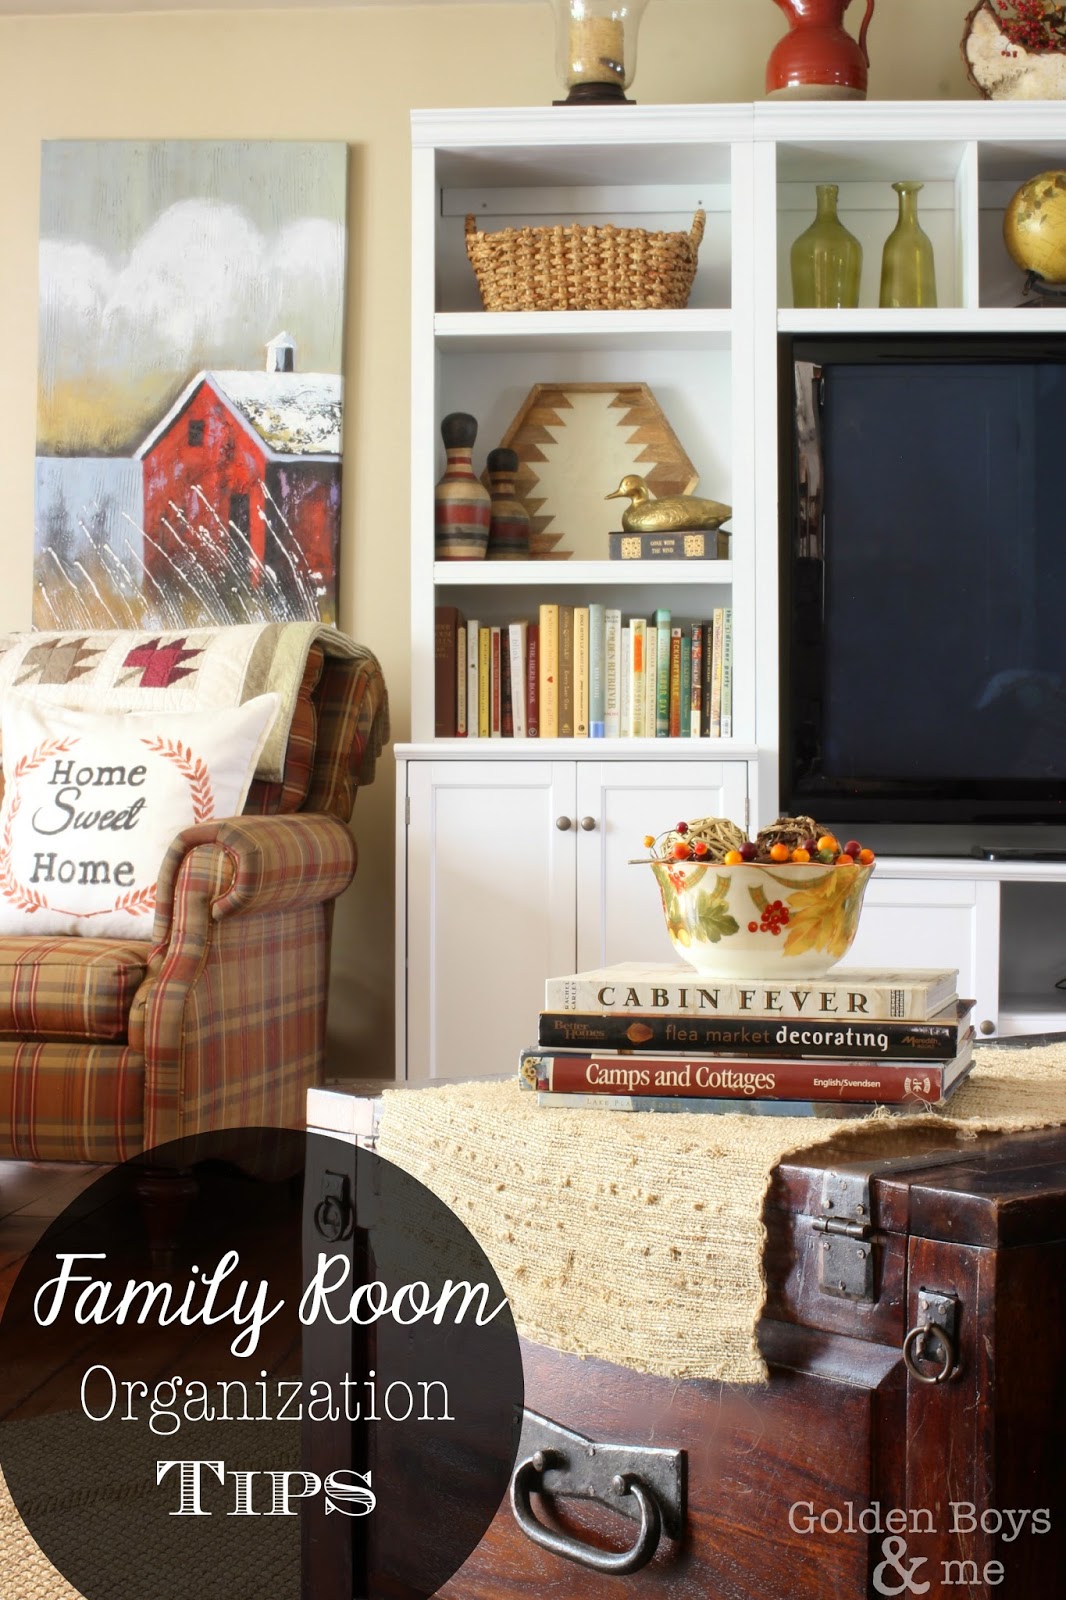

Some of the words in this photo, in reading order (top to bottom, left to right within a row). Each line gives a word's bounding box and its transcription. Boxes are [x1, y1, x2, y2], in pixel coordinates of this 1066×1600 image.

[607, 627, 616, 660] GOLDEN
[672, 639, 680, 674] ECKHART
[607, 662, 616, 709] RETRIEVER
[659, 670, 668, 695] LABOR
[672, 674, 680, 697] TOLLE
[659, 698, 667, 714] DAY
[47, 760, 148, 787] Home
[31, 786, 148, 836] Sweet
[29, 852, 136, 887] Home
[597, 986, 721, 1009] CABIN
[739, 989, 870, 1014] FEVER
[554, 1020, 589, 1030] Better
[564, 1029, 606, 1040] Homes
[665, 1024, 699, 1042] flea
[706, 1026, 771, 1044] market
[775, 1025, 889, 1052] decorating
[585, 1063, 650, 1092] Camps
[654, 1064, 692, 1088] and
[695, 1066, 776, 1096] Cottages
[813, 1078, 881, 1088] English/Svendsen
